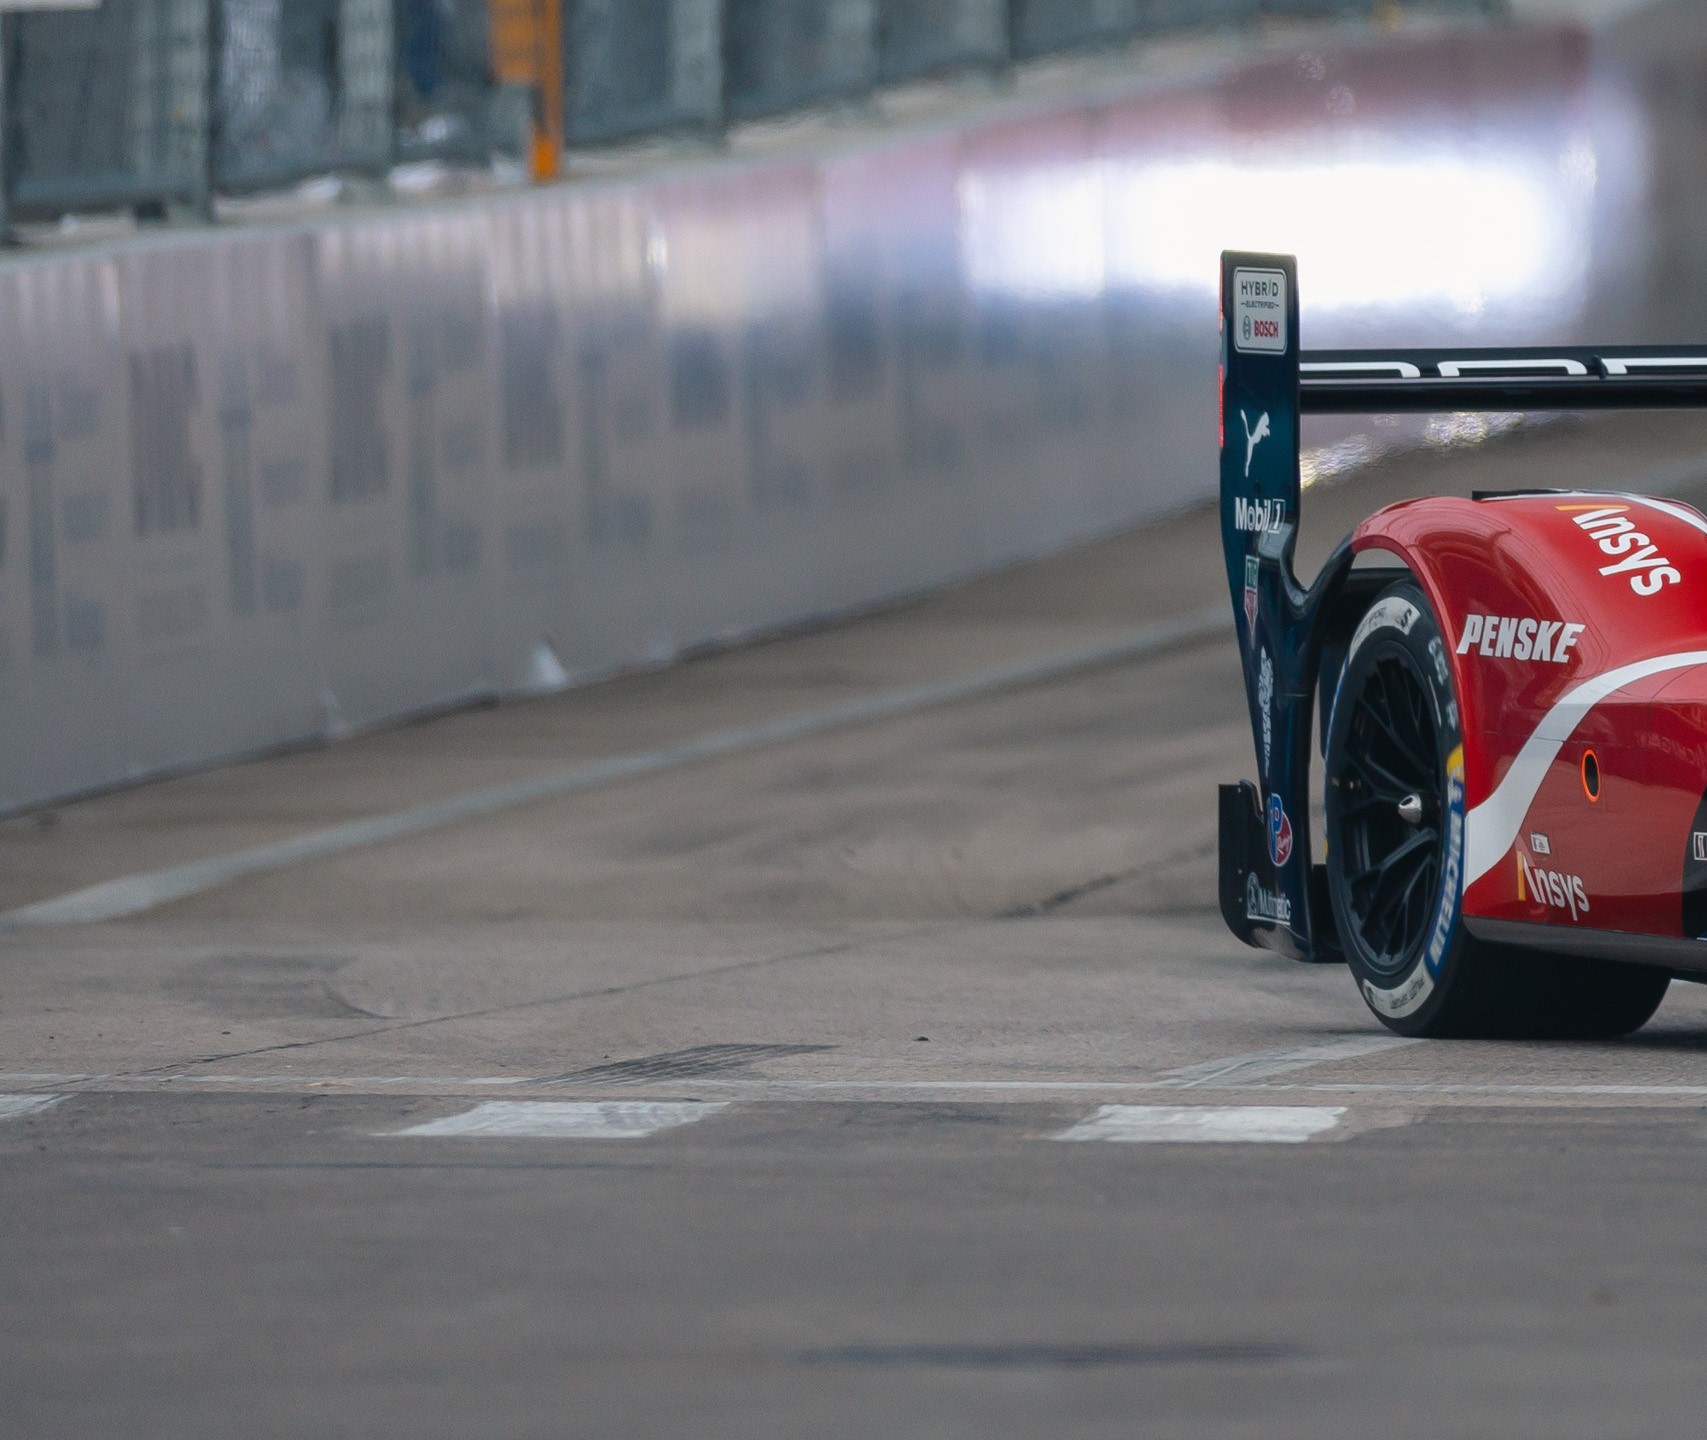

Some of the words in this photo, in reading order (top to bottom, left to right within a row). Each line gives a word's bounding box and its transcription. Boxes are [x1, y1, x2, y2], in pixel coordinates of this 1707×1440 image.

[1241, 278, 1279, 297] HYBRID
[1254, 320, 1279, 338] BOSCH
[1234, 496, 1271, 532] Mobil
[1555, 504, 1681, 596] Ansys
[1456, 614, 1586, 663] PENSKE
[1516, 850, 1590, 921] Ansys
